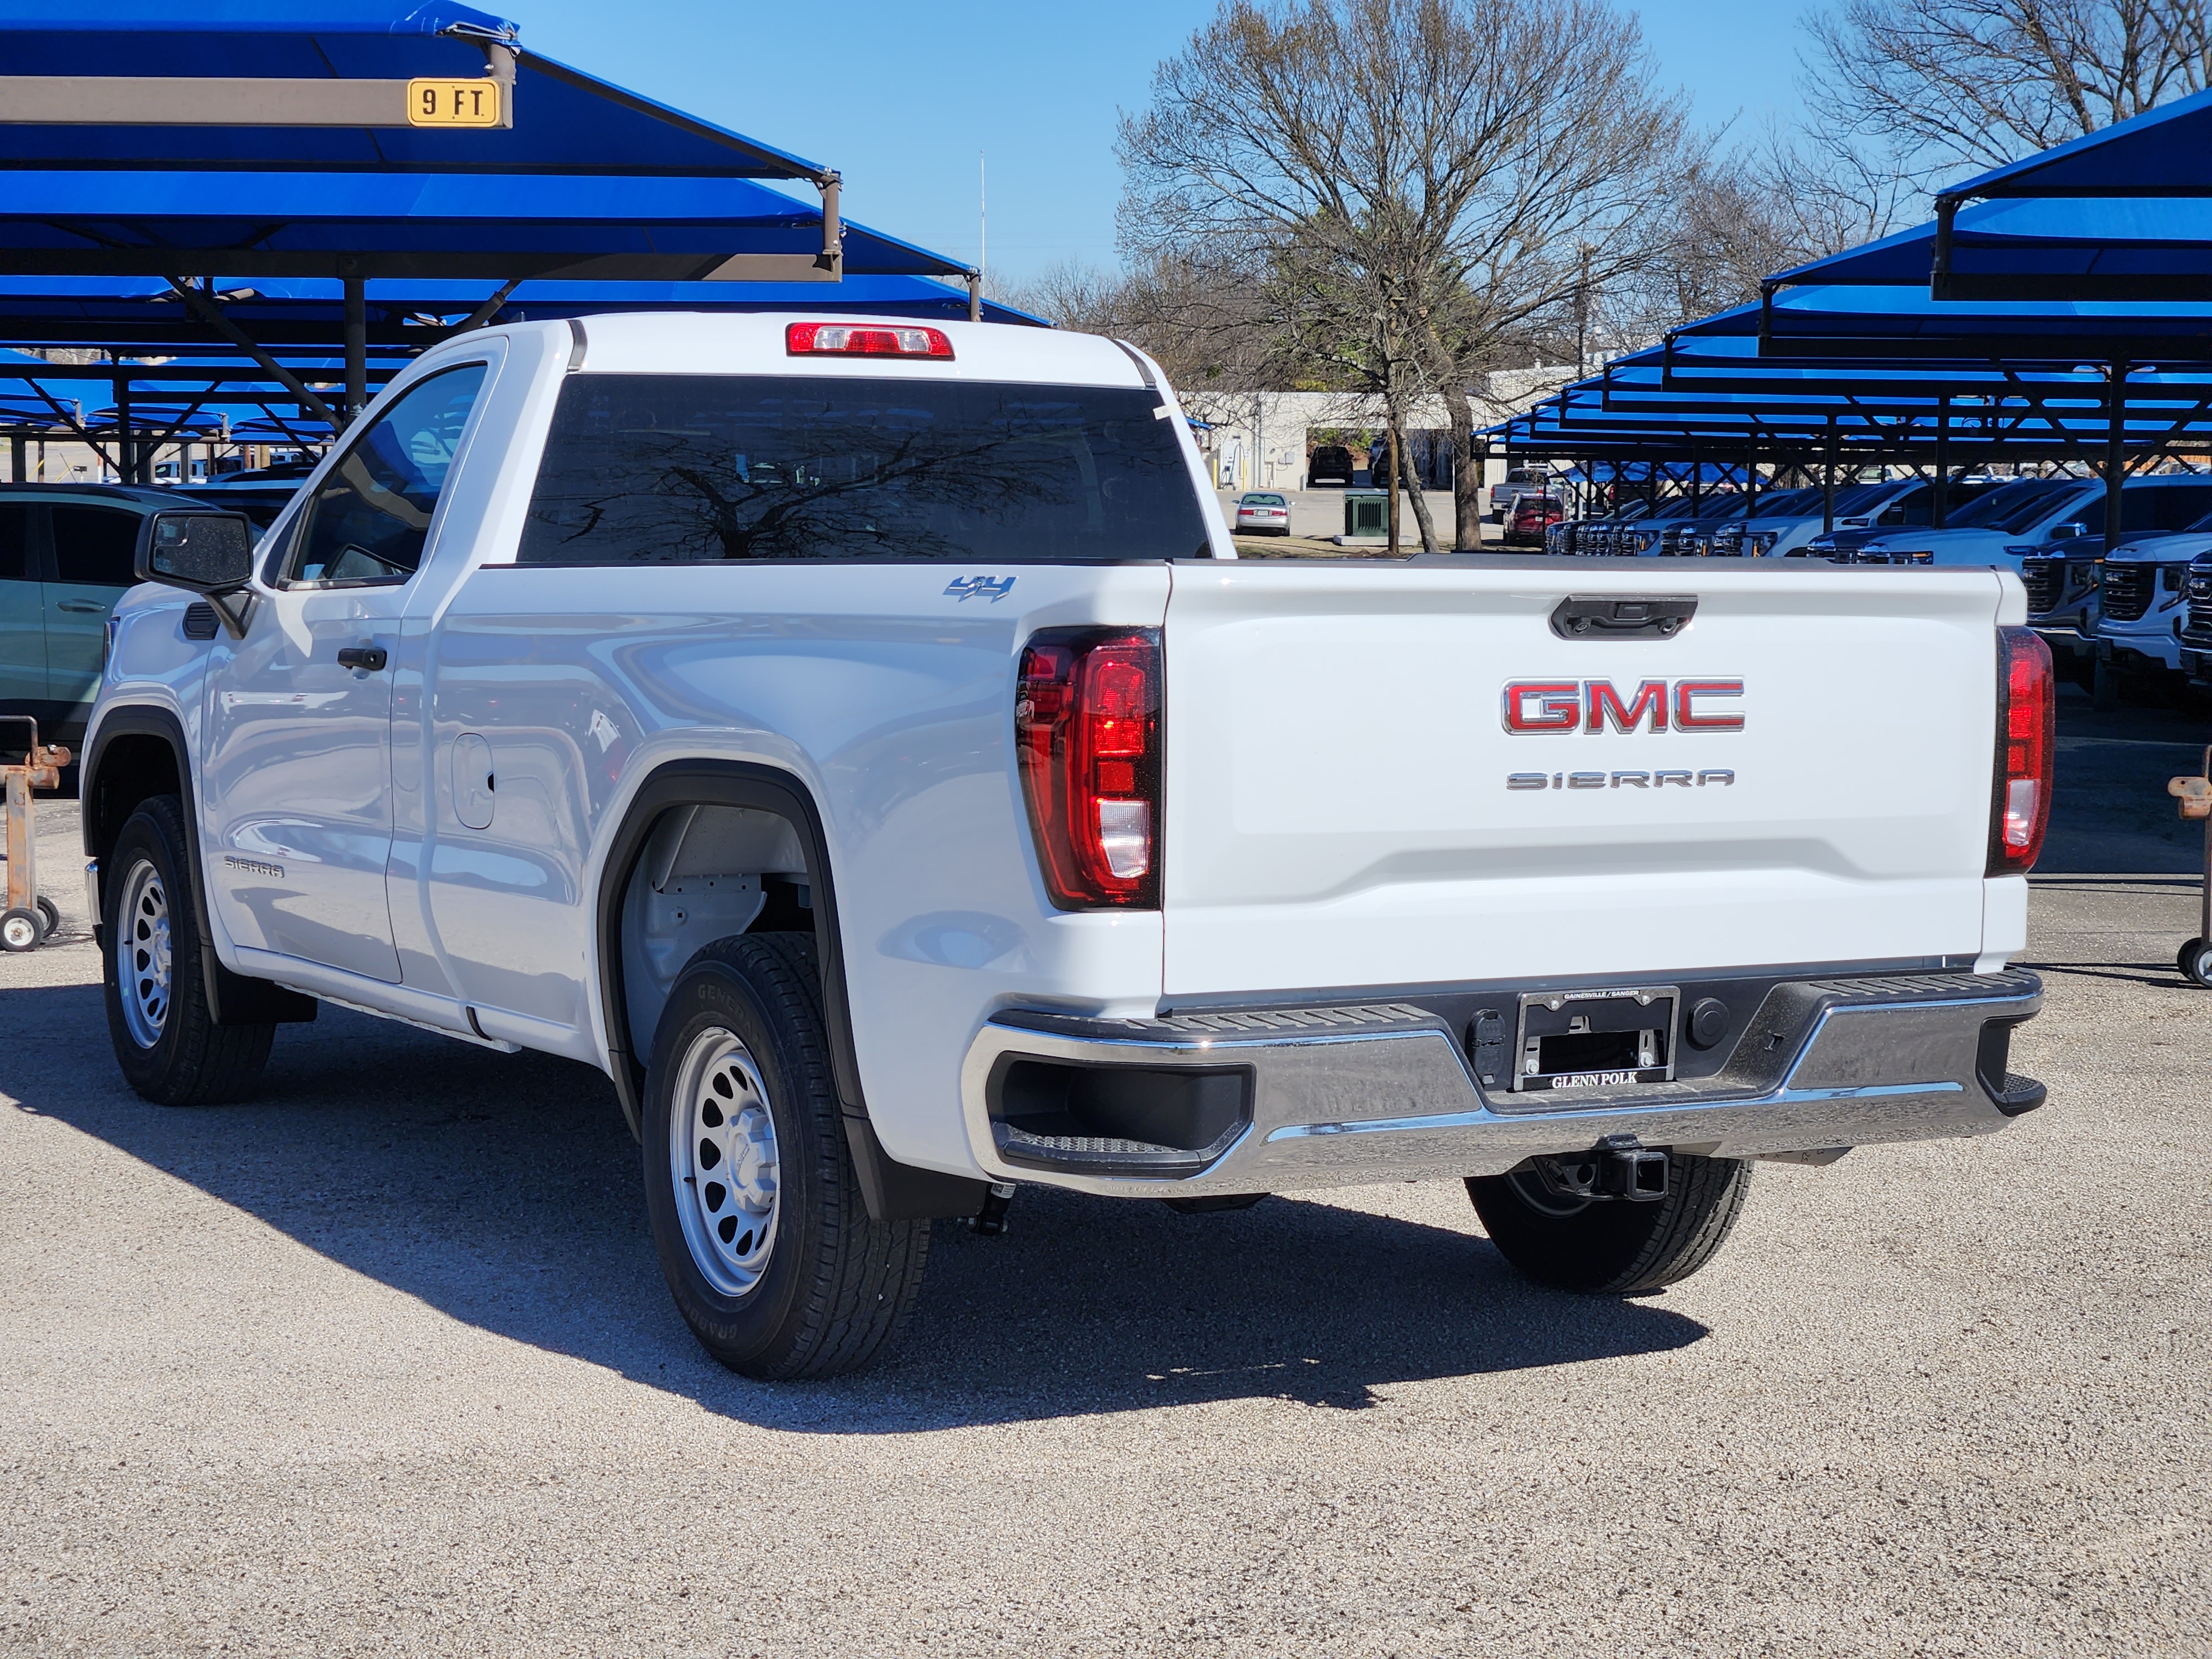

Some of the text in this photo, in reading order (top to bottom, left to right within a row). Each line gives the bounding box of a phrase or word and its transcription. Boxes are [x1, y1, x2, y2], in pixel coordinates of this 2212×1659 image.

[422, 89, 436, 114] 9
[1501, 677, 1745, 735] GMC
[1506, 769, 1735, 790] SIERRA
[223, 855, 285, 878] SIERRA
[1552, 1072, 1637, 1089] GLENN POLK
